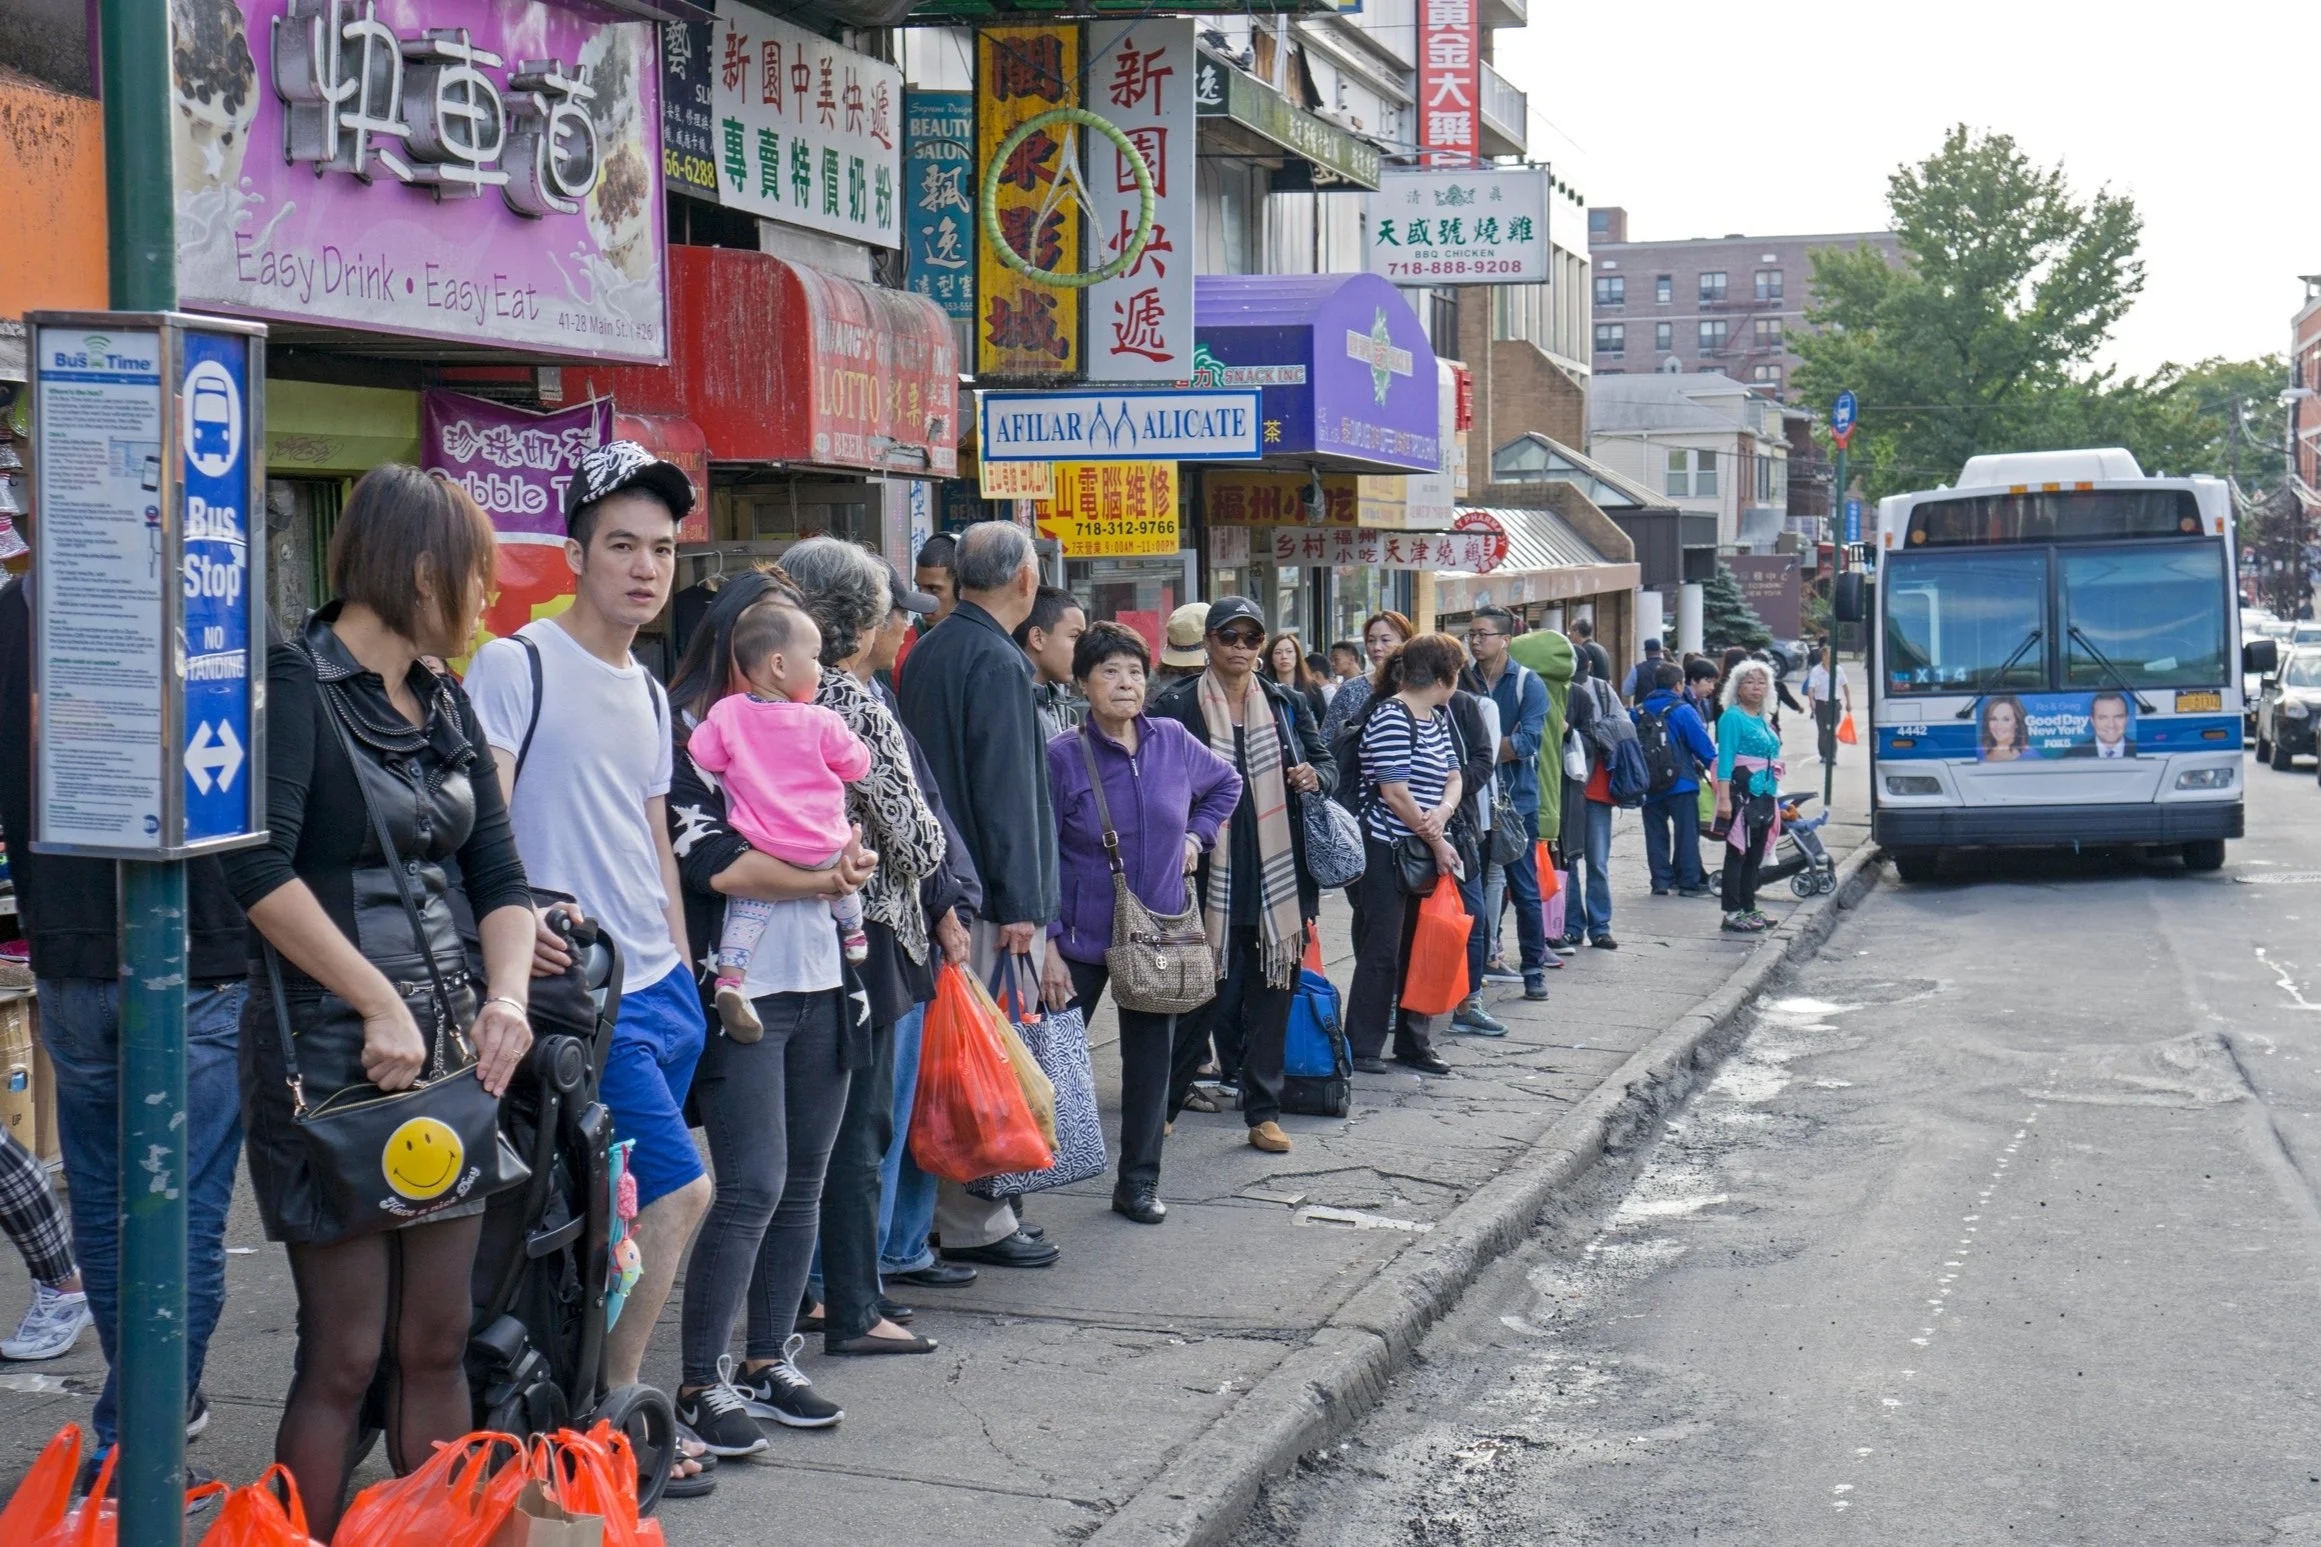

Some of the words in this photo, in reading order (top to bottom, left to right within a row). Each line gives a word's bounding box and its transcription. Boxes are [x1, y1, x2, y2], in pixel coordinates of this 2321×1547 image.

[722, 17, 892, 150] 新園中美快遞
[910, 118, 972, 138] BEAUTY
[914, 141, 971, 160] SALON
[722, 116, 893, 230] 專賣特價奶粉
[1109, 37, 1175, 363] 新園快遞
[1415, 251, 1438, 259] BBQ
[1444, 249, 1495, 258] CHICKEN
[236, 232, 315, 304] Easy
[322, 246, 395, 302] Drink
[425, 262, 488, 327] Easy
[493, 273, 540, 322] Eat
[1388, 260, 1522, 276] 718-888-9208
[559, 312, 587, 333] 41-28
[589, 316, 613, 337] Main
[615, 319, 629, 338] St.
[55, 352, 88, 369] Bus
[105, 354, 151, 371] Time
[1225, 368, 1273, 384] SNACK
[1278, 366, 1305, 382] INC
[819, 366, 880, 424] LOTTO
[996, 411, 1083, 444] AFILAR
[1142, 406, 1246, 440] ALICATE
[1262, 420, 1282, 443] 茶
[442, 420, 600, 471] 珍珠奶茶
[187, 496, 237, 538] Bus
[1075, 520, 1175, 536] 718-312-9766
[1276, 533, 1327, 560] 乡村
[1333, 529, 1377, 546] 福州
[1335, 548, 1378, 564] 小吃
[184, 553, 240, 606] Stop
[204, 625, 224, 651] NO
[1896, 726, 1928, 736] 4442
[2024, 714, 2063, 727] Good
[2063, 714, 2090, 728] Day
[2027, 725, 2057, 736] New
[2058, 725, 2085, 736] York
[379, 1197, 417, 1217] Have
[456, 1166, 481, 1198] Day
